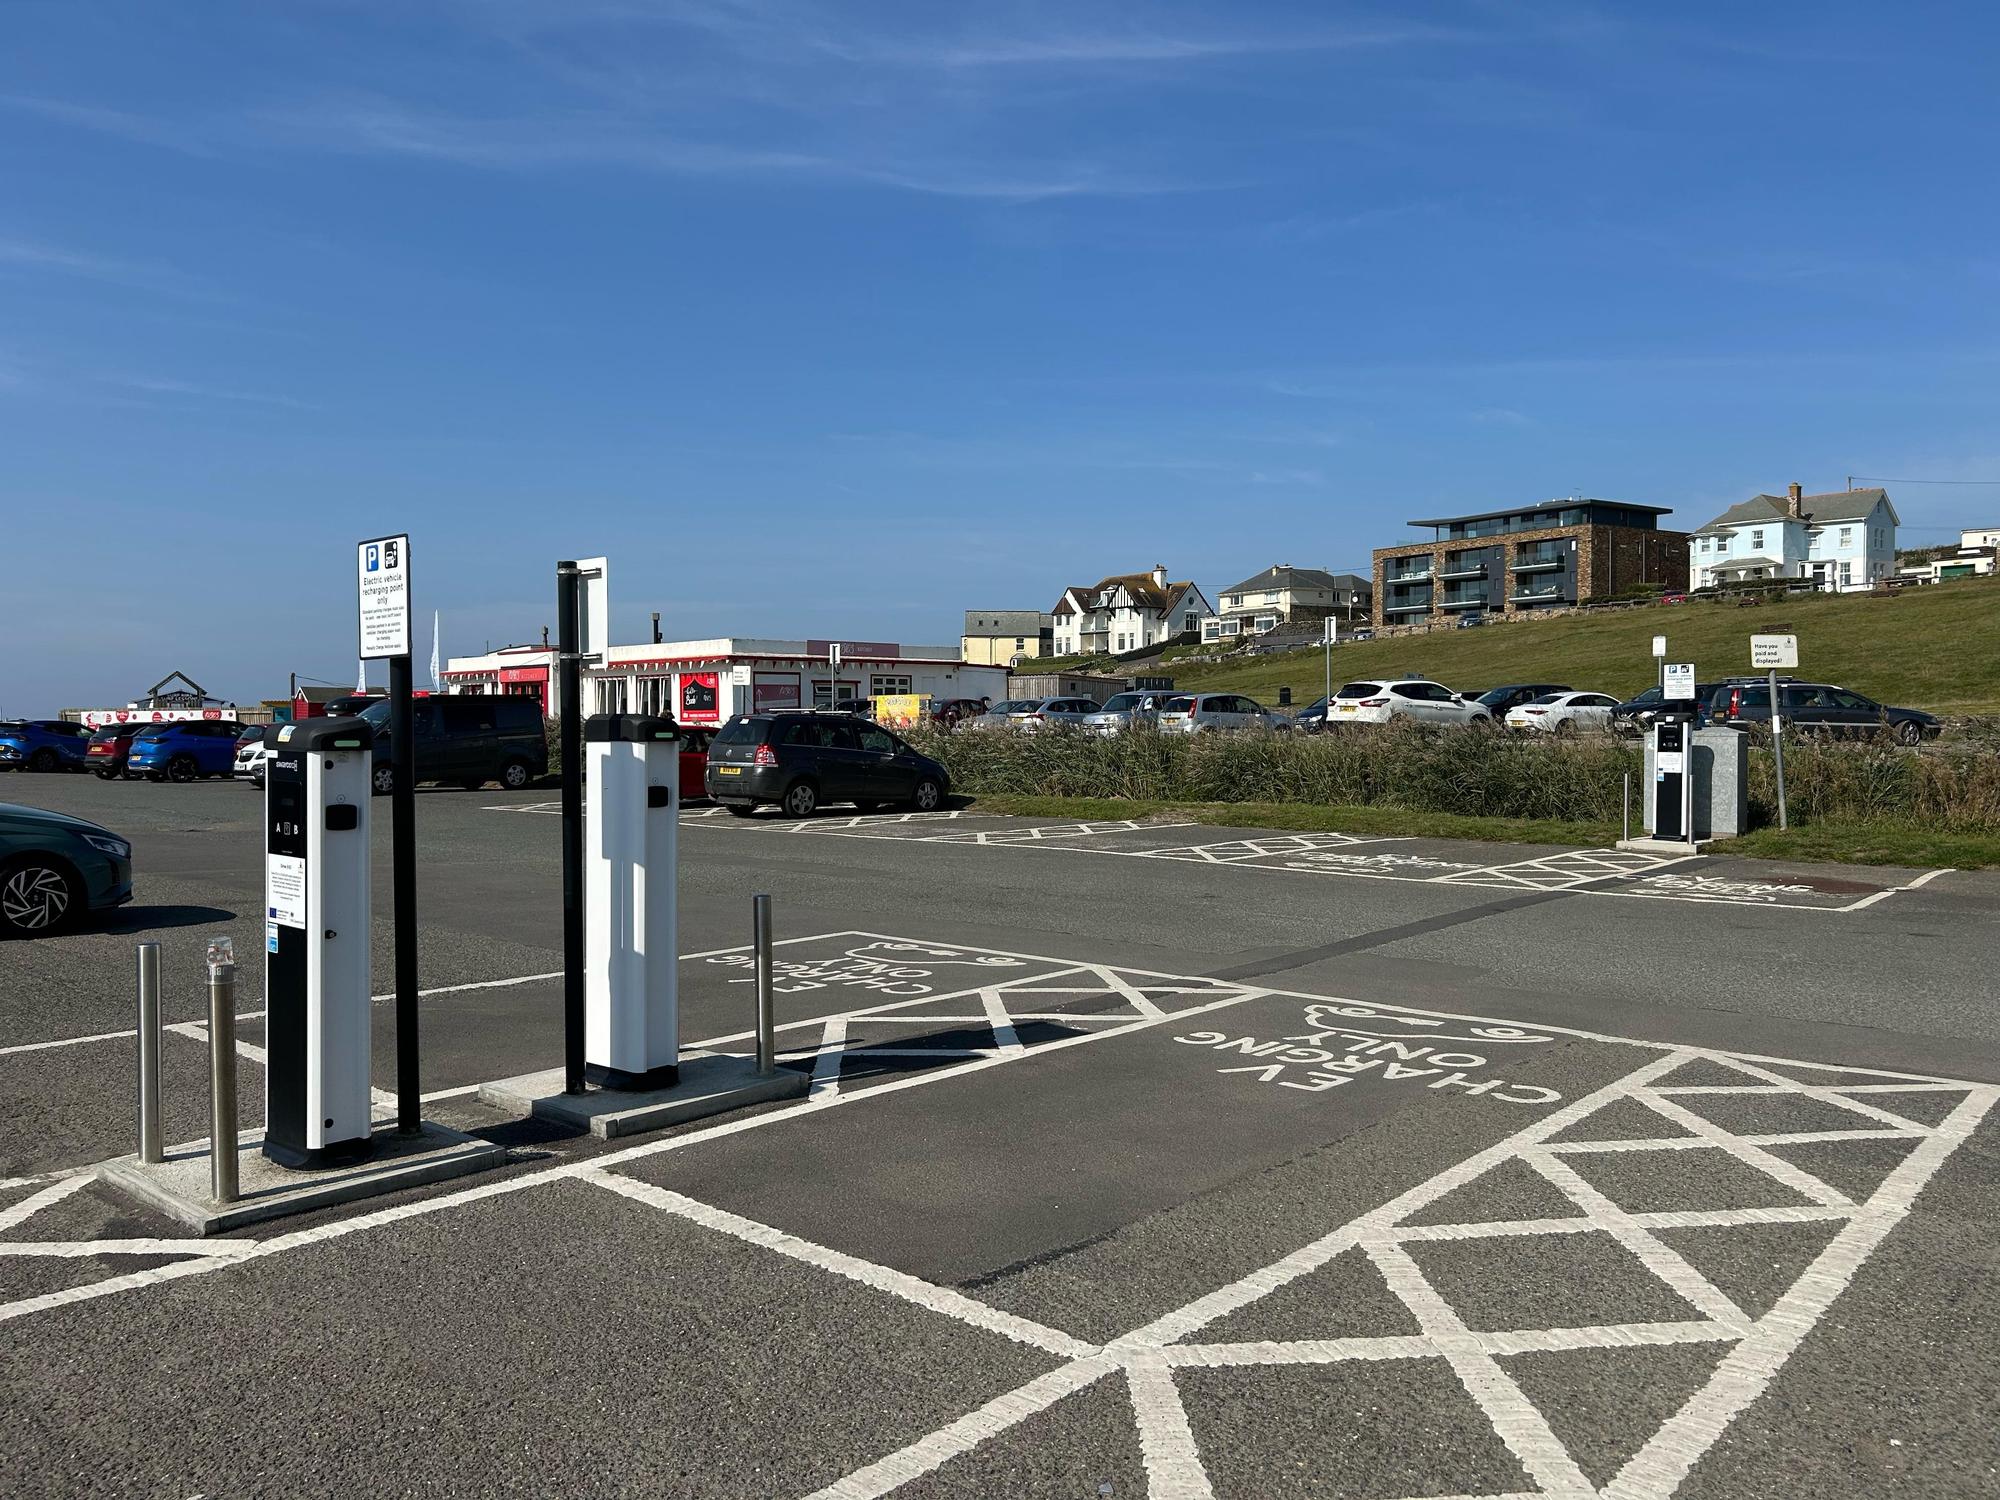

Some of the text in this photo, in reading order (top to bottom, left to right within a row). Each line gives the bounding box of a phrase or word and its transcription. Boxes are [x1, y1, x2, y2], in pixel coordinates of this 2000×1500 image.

[367, 547, 377, 570] P
[363, 573, 402, 586] Electric vehicle
[362, 583, 404, 596] recharging point
[377, 596, 388, 605] only
[1755, 657, 1783, 665] displayed?
[275, 822, 299, 835] A B
[805, 957, 933, 978] ONLY
[1283, 1031, 1487, 1067] ONLY
[1173, 1031, 1562, 1104] CHARGING
[1216, 1063, 1354, 1092] EV
